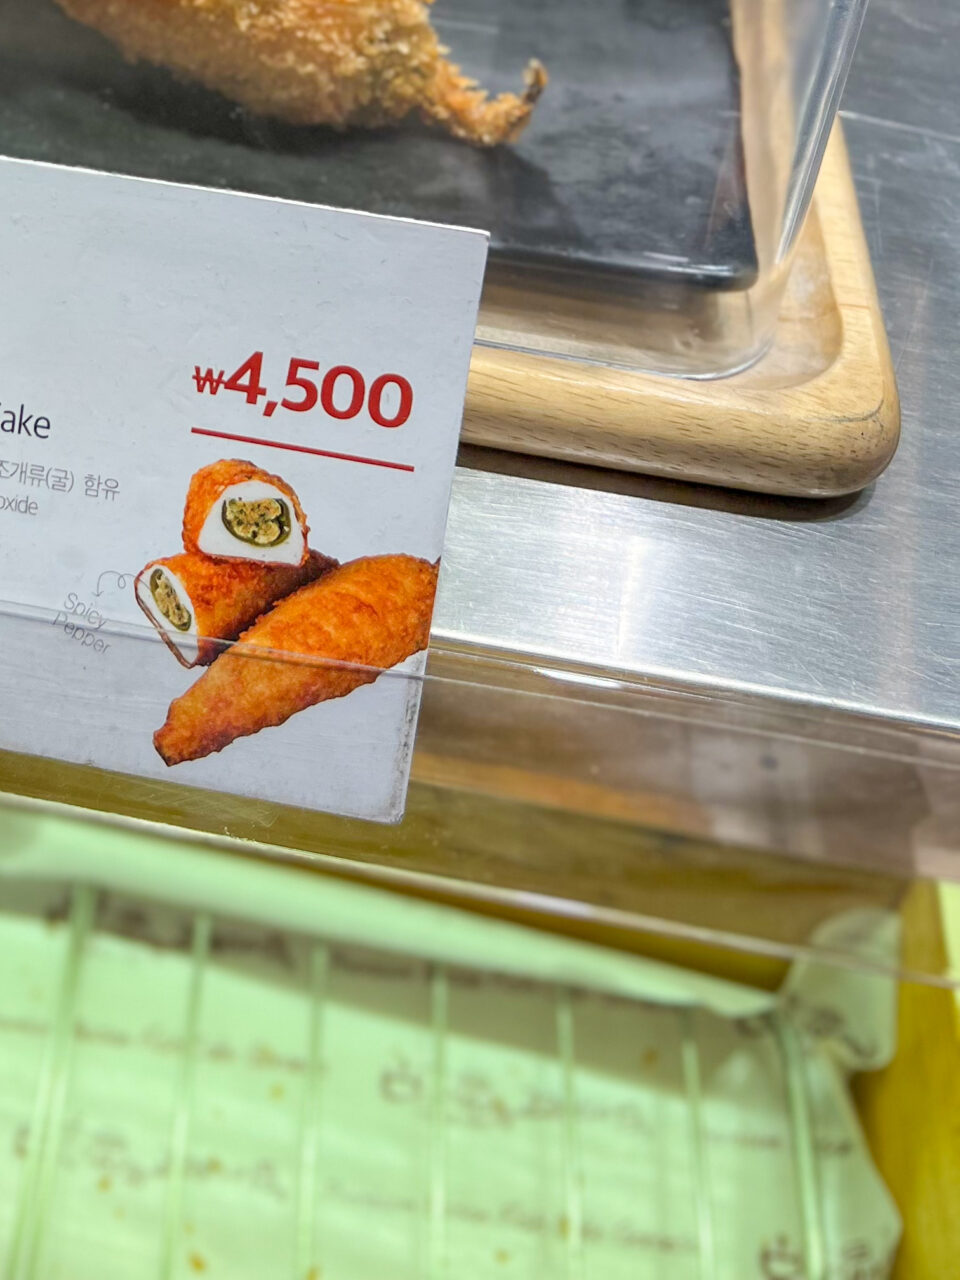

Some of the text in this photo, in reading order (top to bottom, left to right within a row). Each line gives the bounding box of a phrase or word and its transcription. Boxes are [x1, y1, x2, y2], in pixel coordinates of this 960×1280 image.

[192, 351, 414, 429] ₩4,500
[83, 474, 121, 502] 함유
[63, 592, 108, 631] Spicy
[52, 611, 112, 655] Pepper
